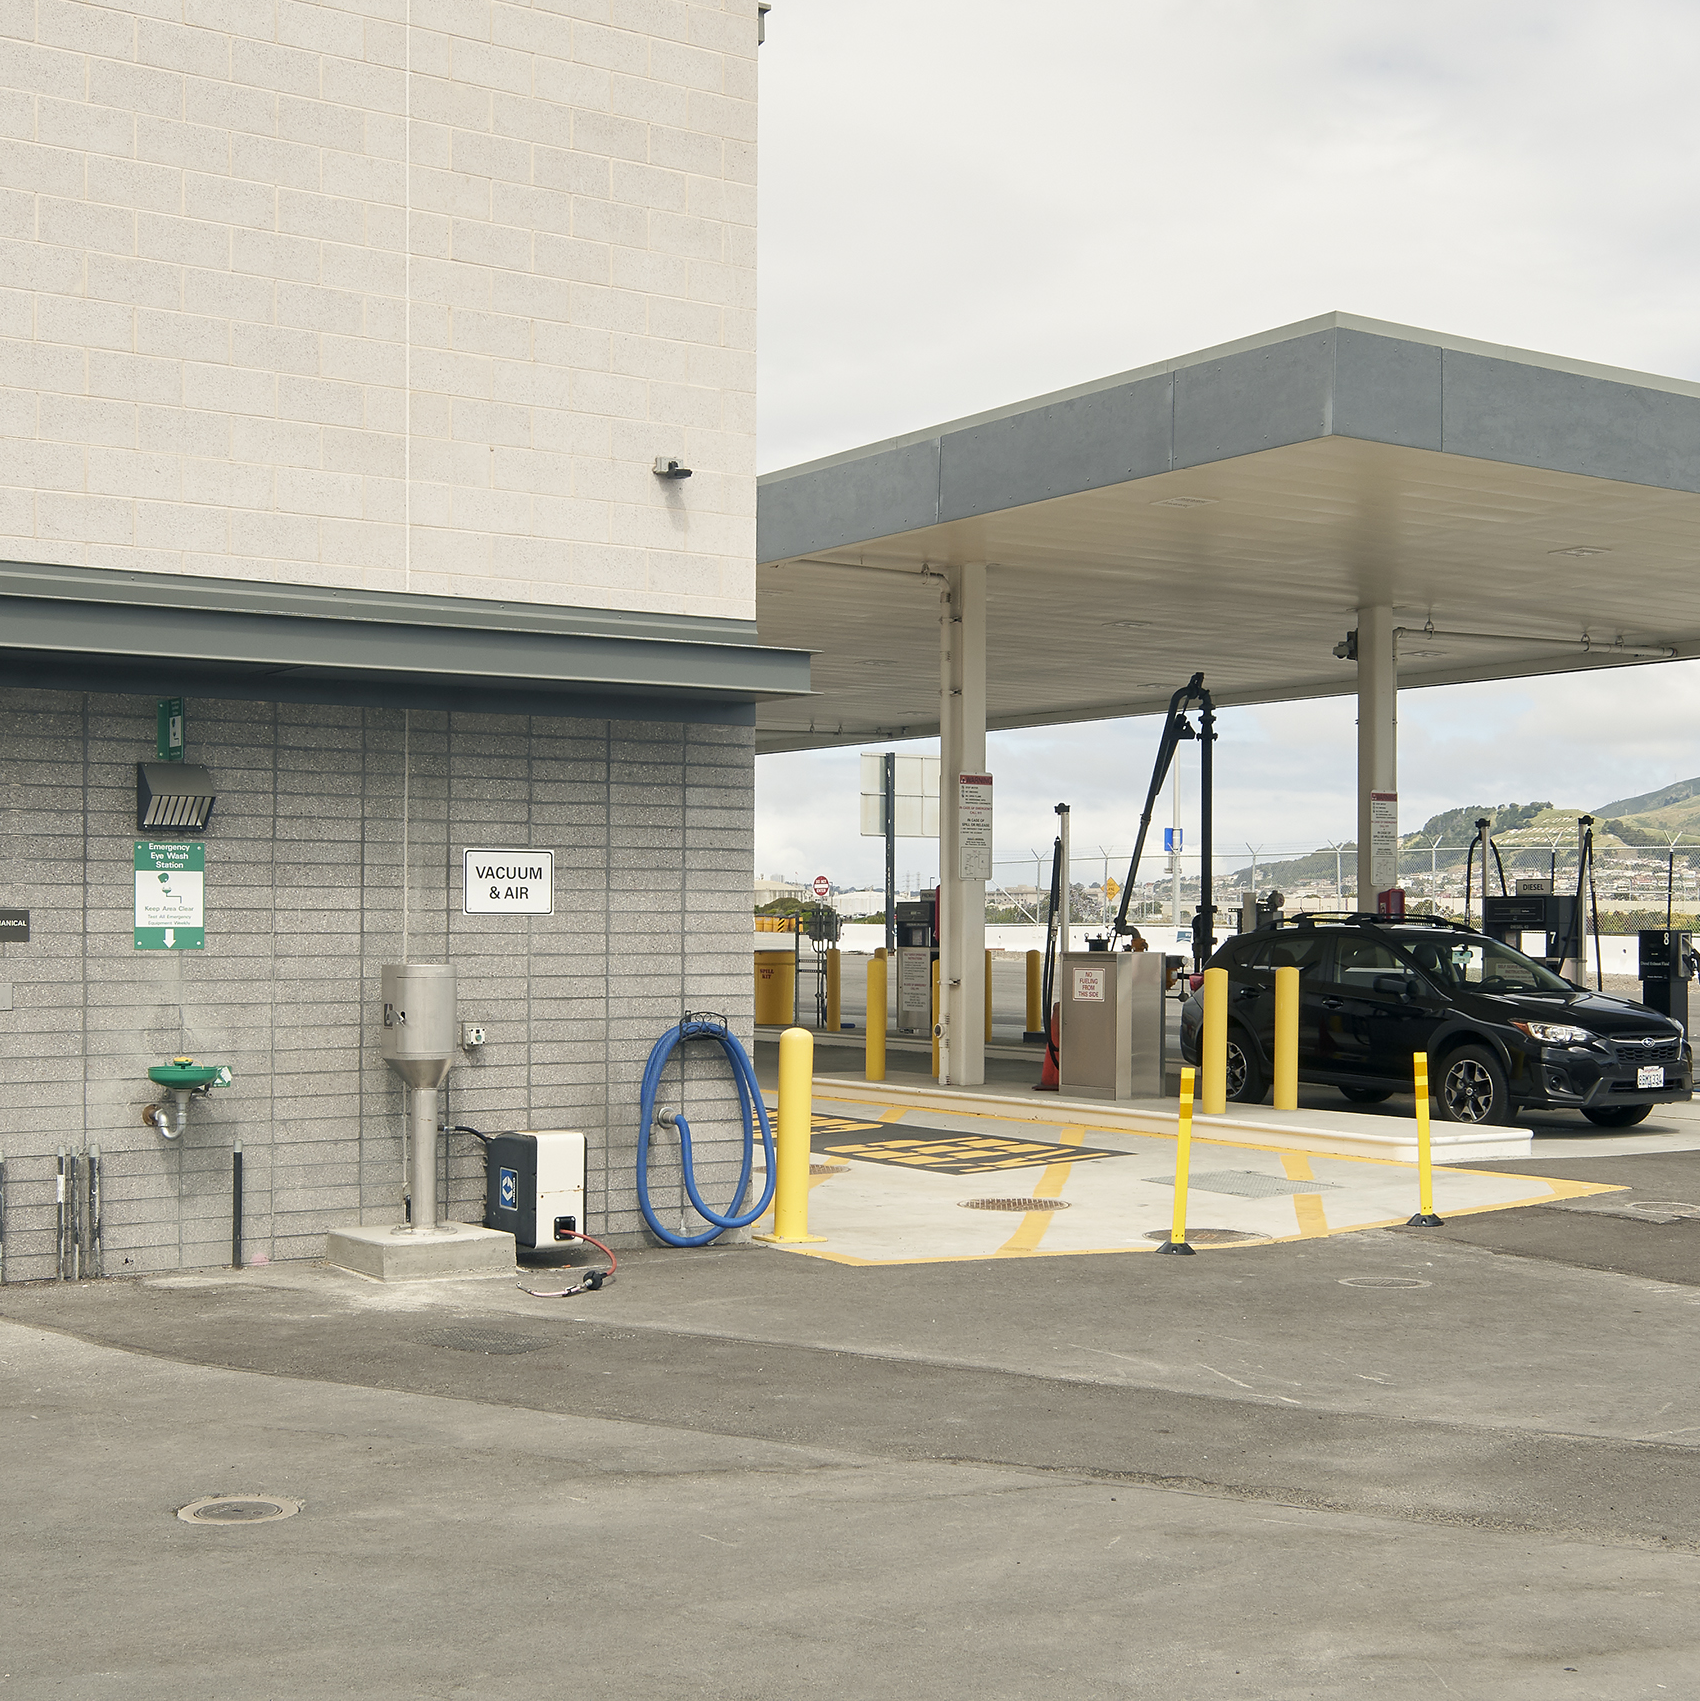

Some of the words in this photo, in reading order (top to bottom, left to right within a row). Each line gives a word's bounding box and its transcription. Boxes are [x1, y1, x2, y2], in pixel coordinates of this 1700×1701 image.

[148, 843, 190, 852] Emergency
[475, 866, 542, 879] VACUUM
[490, 886, 500, 899] &
[504, 887, 528, 899] AIR
[1549, 931, 1556, 944] 7
[1664, 932, 1669, 945] 8
